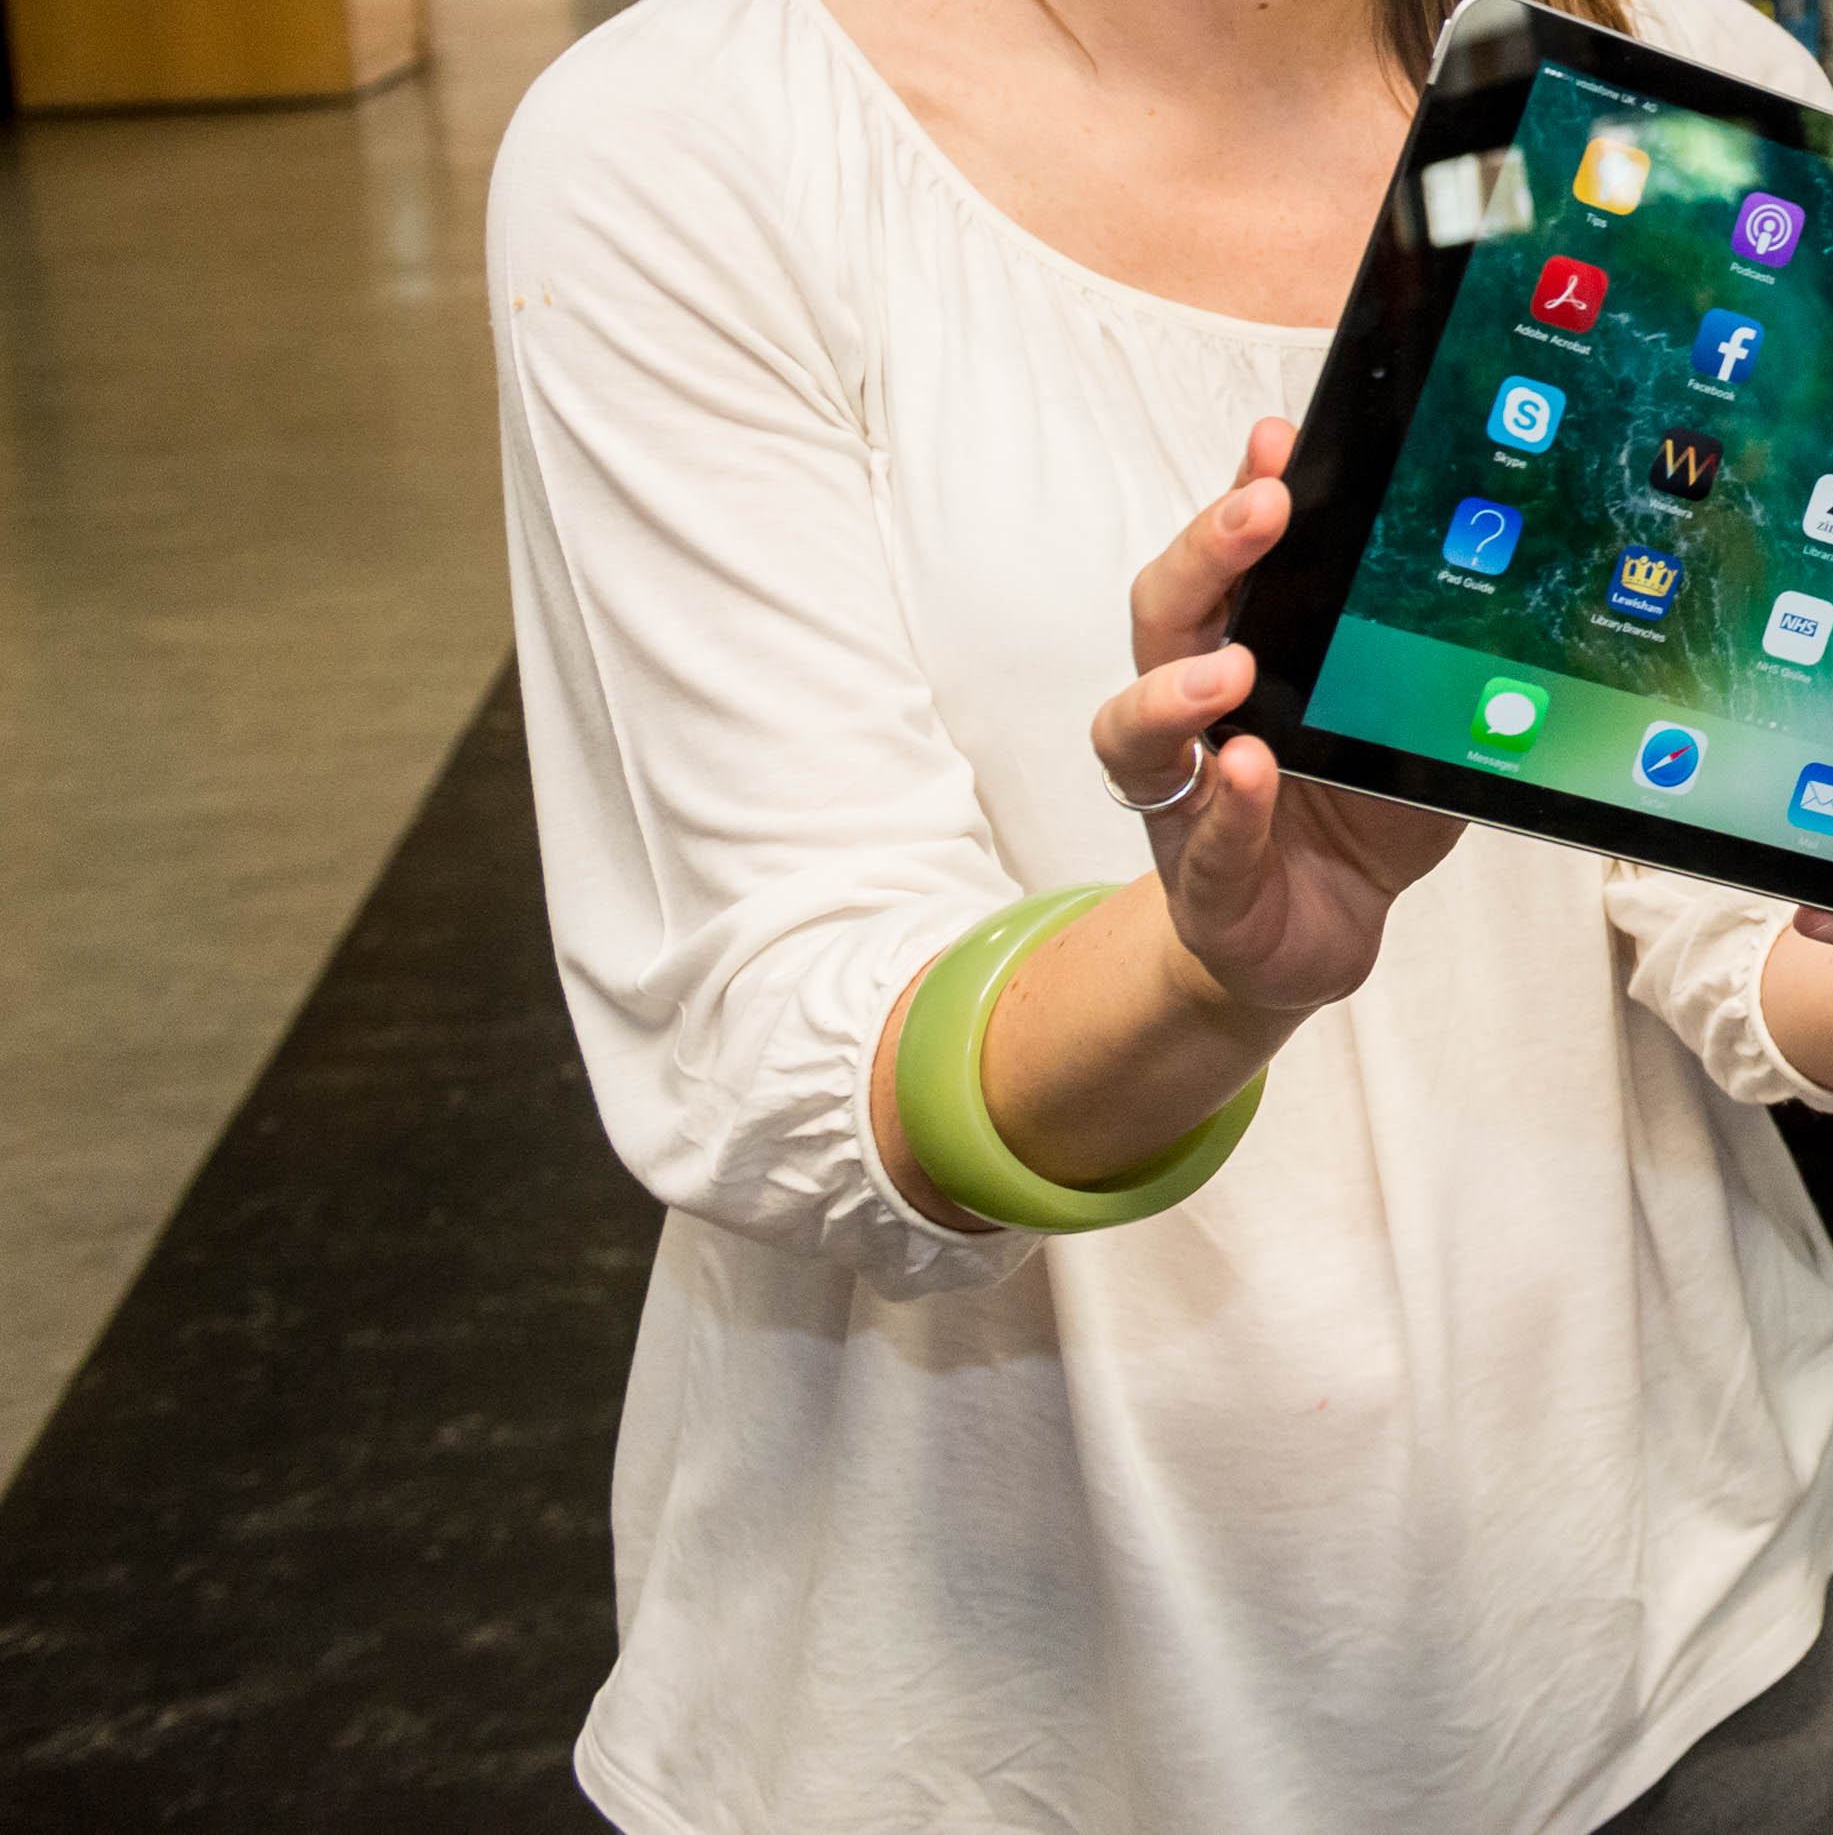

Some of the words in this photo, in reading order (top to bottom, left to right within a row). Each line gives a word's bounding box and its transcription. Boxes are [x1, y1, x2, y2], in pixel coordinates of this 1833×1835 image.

[1621, 92, 1637, 107] UK
[1586, 212, 1607, 229] Tips
[1729, 262, 1776, 286] Podcasts
[1513, 323, 1551, 344] Adobe
[1549, 333, 1592, 356] Acrobat
[1687, 379, 1736, 402] Facebook
[1493, 450, 1528, 471] Skype
[1648, 497, 1693, 519] Wandera
[1437, 569, 1461, 587] iPad
[1461, 576, 1496, 596] Guide
[1611, 593, 1664, 616] Lewisham
[1590, 613, 1624, 634] Library
[1622, 621, 1666, 644] Branches
[1782, 613, 1818, 636] NHS
